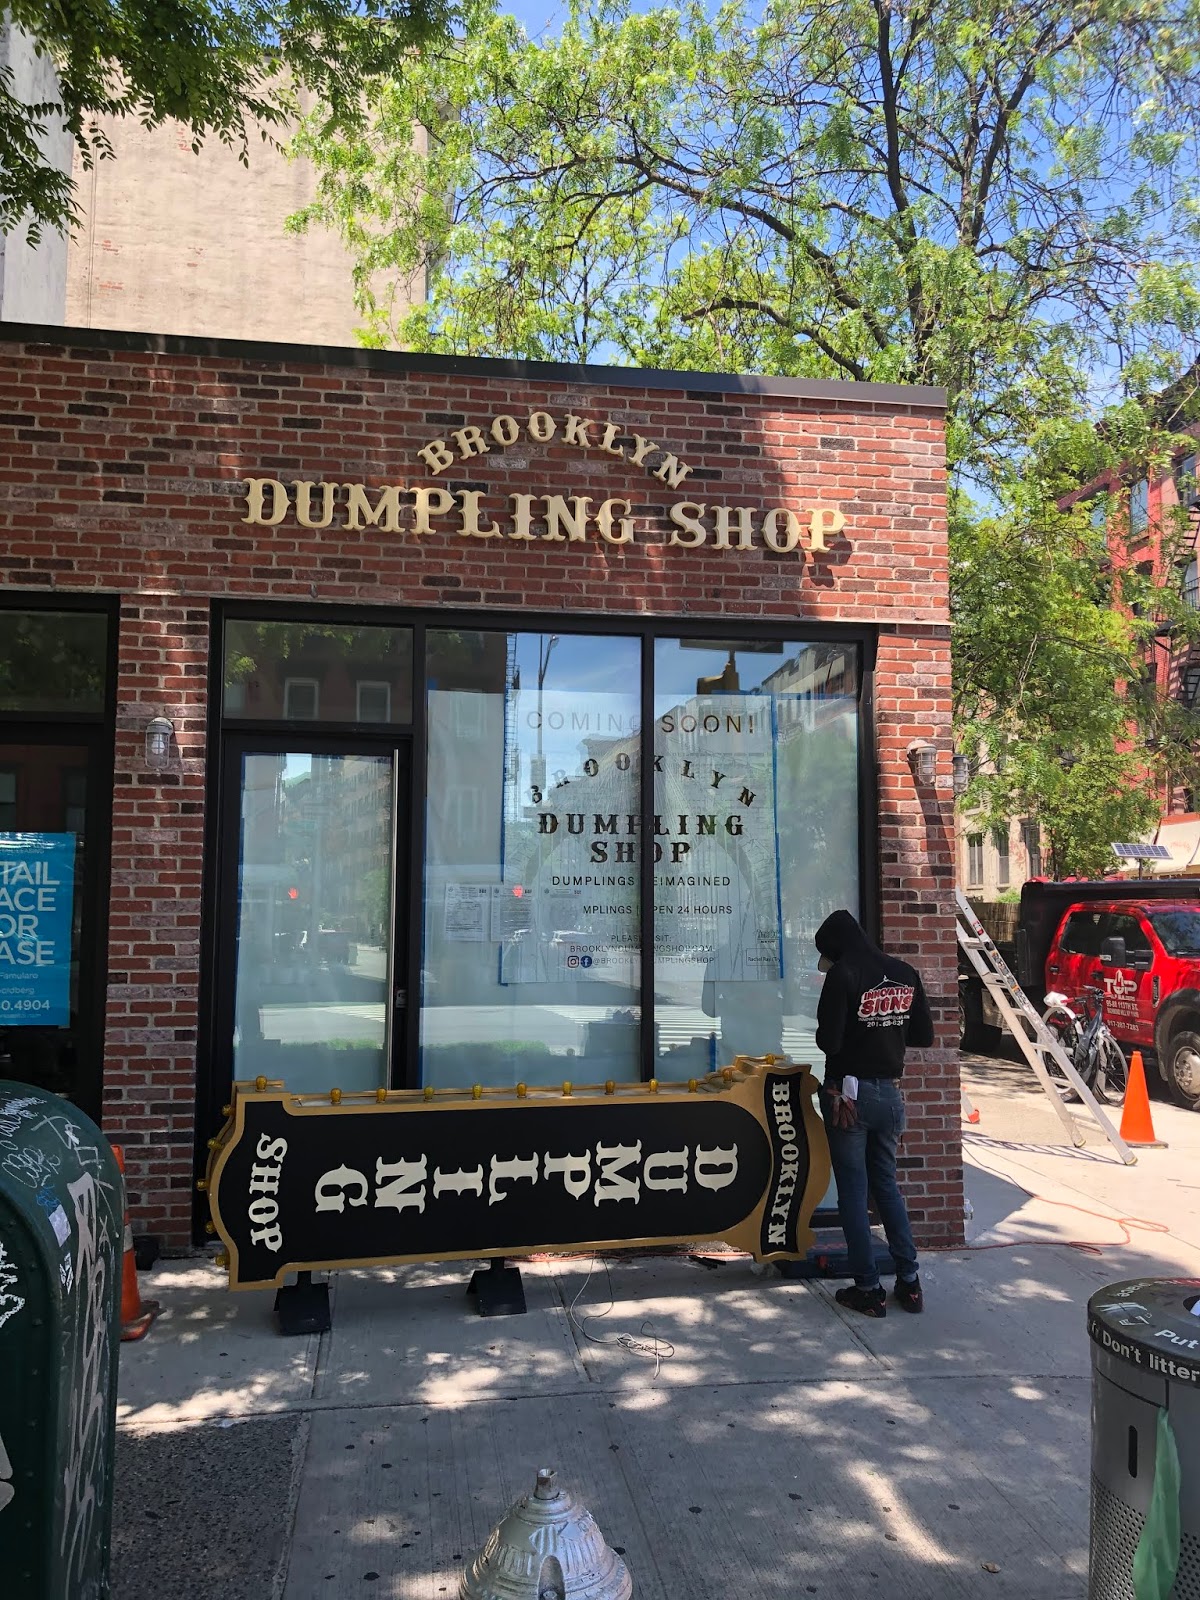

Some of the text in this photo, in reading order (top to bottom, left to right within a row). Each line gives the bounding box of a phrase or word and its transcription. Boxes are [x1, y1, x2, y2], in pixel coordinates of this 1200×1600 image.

[417, 411, 694, 490] BROOKLYN
[240, 477, 848, 555] DUMPLING SHOP
[661, 714, 754, 733] SOON!
[0, 861, 60, 885] TAIL
[552, 876, 731, 887] DUMPLINGS EIMAGINED
[583, 905, 733, 914] MPLINGS PEN 24 HOURS
[611, 934, 641, 943] PLEAS
[1, 999, 51, 1011] 0.4904
[858, 996, 914, 1017] SIGNS
[766, 1080, 803, 1247] BROOKLYN
[314, 1138, 739, 1215] DUMPLING
[248, 1132, 288, 1253] SHOP
[1154, 1329, 1200, 1349] Put
[1102, 1329, 1142, 1363] Don't
[1149, 1353, 1200, 1381] litter
